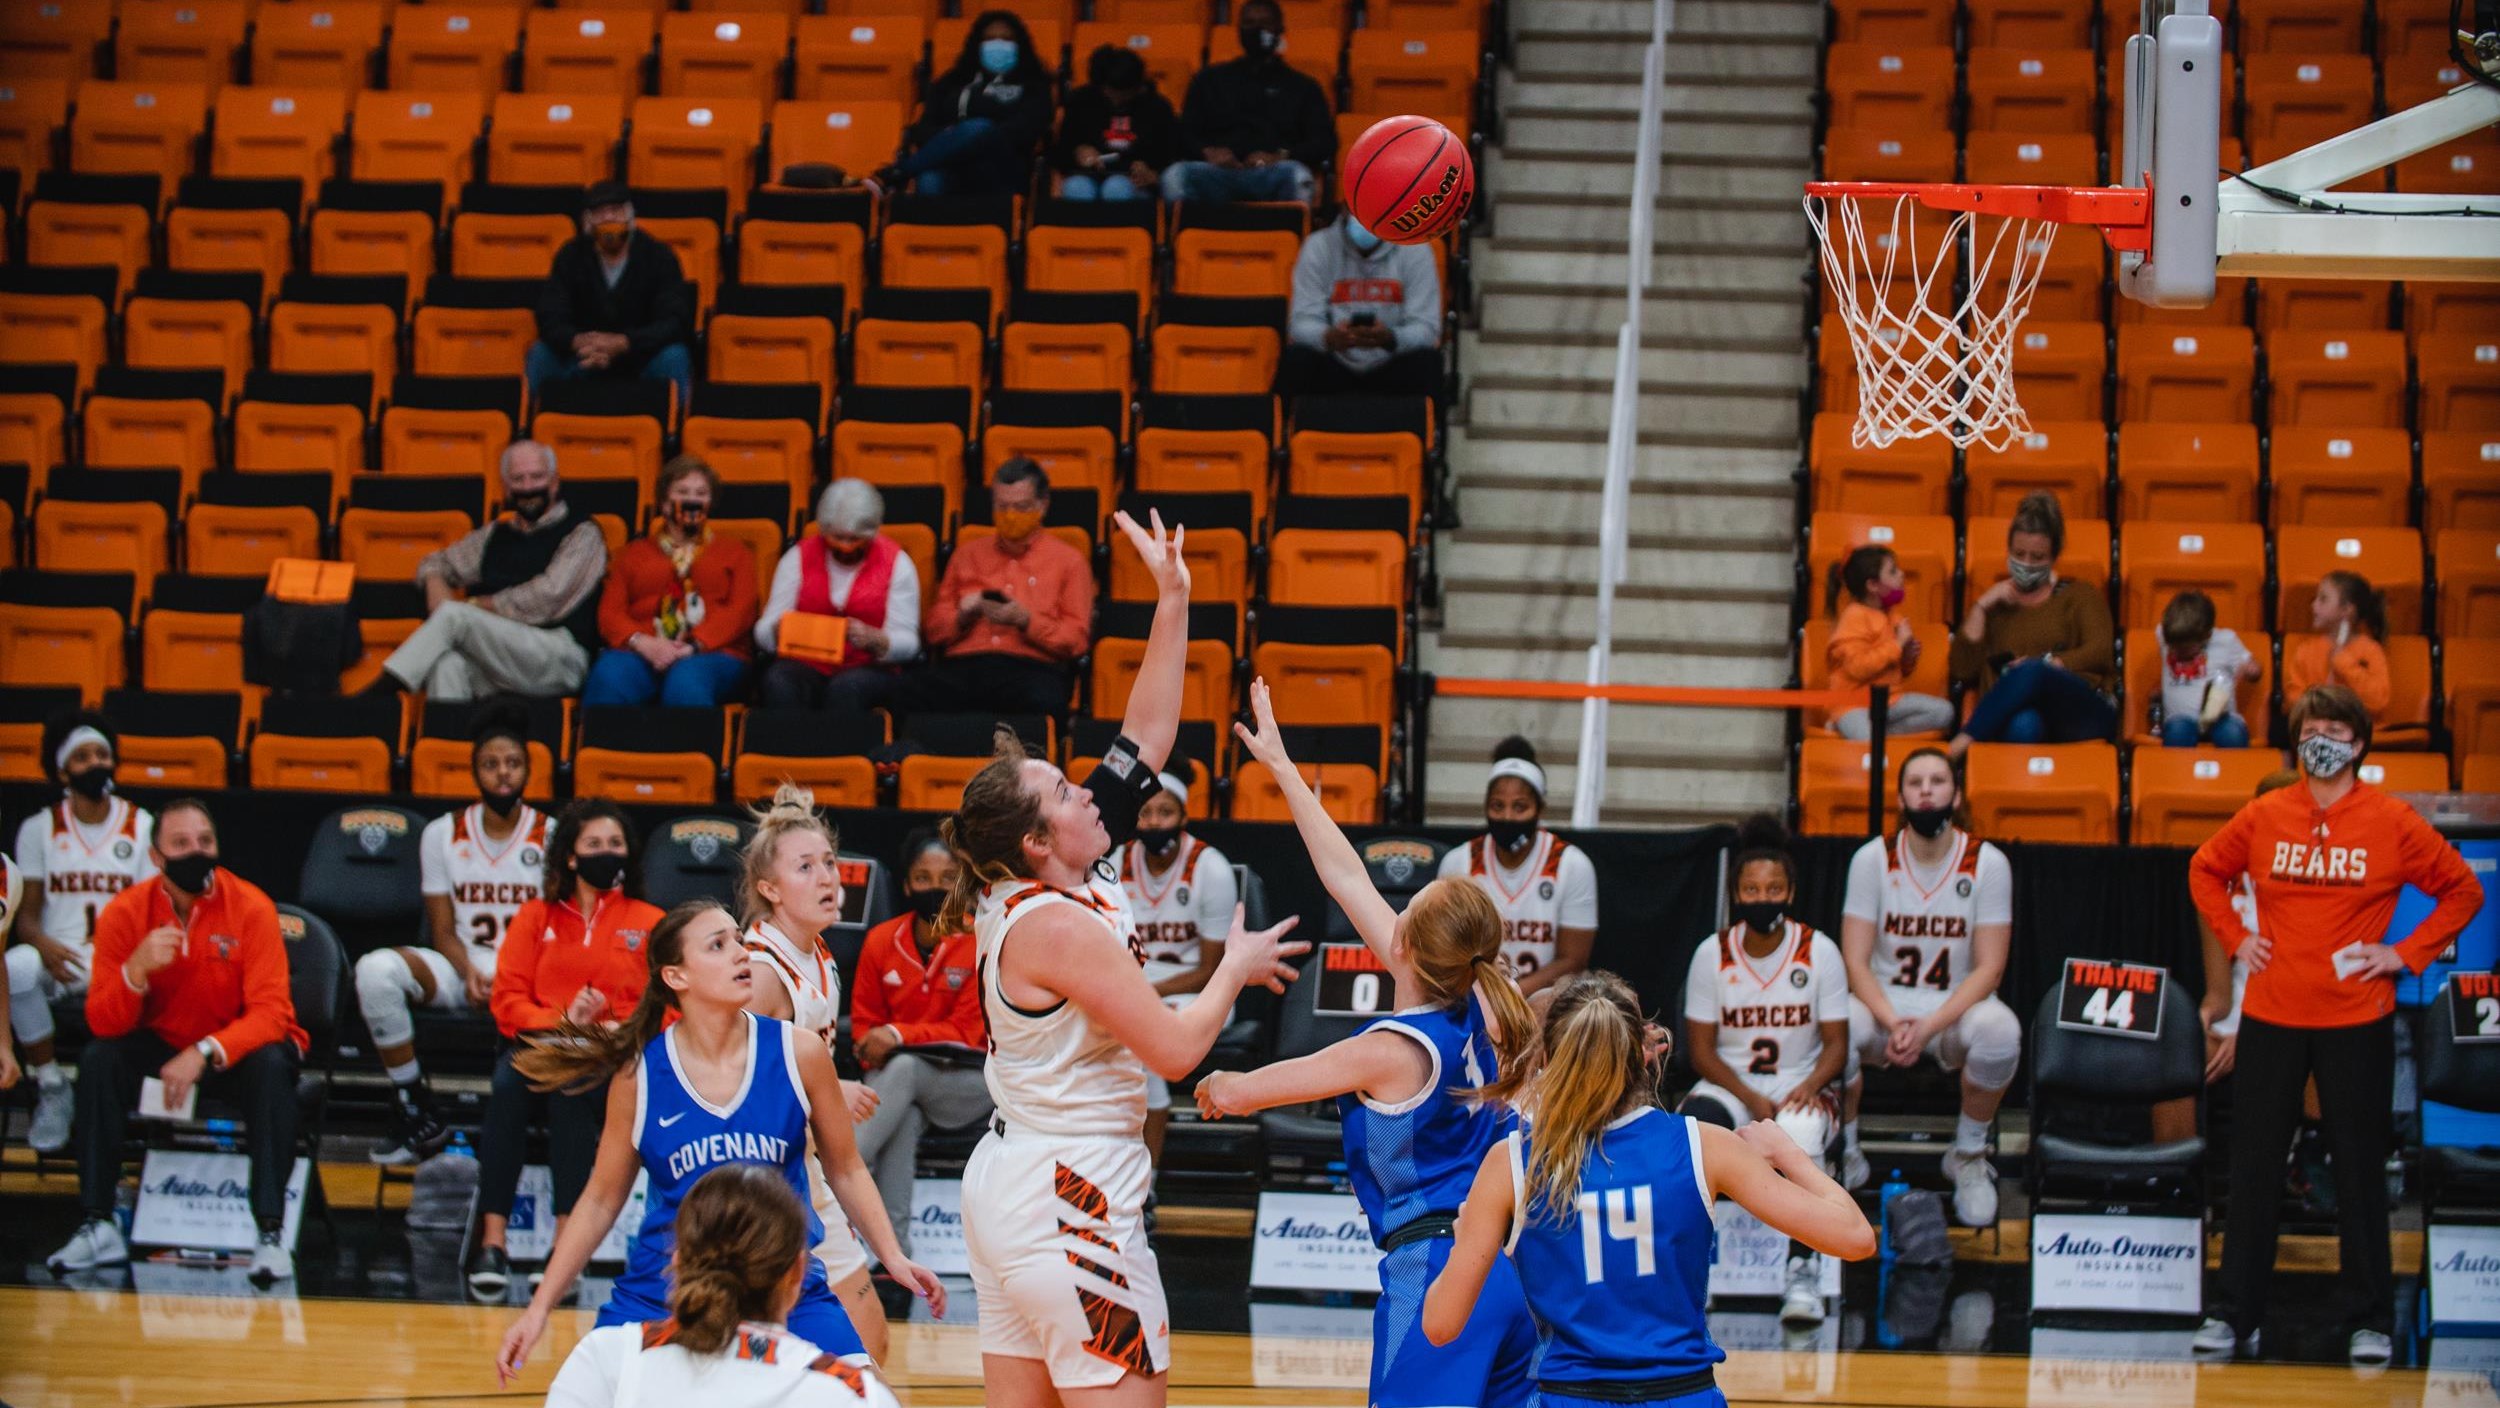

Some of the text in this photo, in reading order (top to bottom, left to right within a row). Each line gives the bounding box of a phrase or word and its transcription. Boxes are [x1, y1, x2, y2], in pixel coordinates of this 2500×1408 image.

[1391, 165, 1460, 232] Wilson
[2271, 841, 2368, 880] BEARS
[1136, 920, 1199, 943] ERCER
[1885, 911, 1967, 938] MERCER
[1891, 945, 1951, 991] 34
[2072, 961, 2157, 994] THAYNE
[1351, 973, 1380, 1012] 0
[2081, 987, 2135, 1030] 44
[1720, 1003, 1812, 1028] MERCER
[1748, 1037, 1780, 1075] 2
[668, 1131, 789, 1181] COVENANT
[1261, 1216, 1372, 1241] Auto-Ow
[1577, 1183, 1656, 1285] 14
[2038, 1232, 2198, 1260] Auto-Owners
